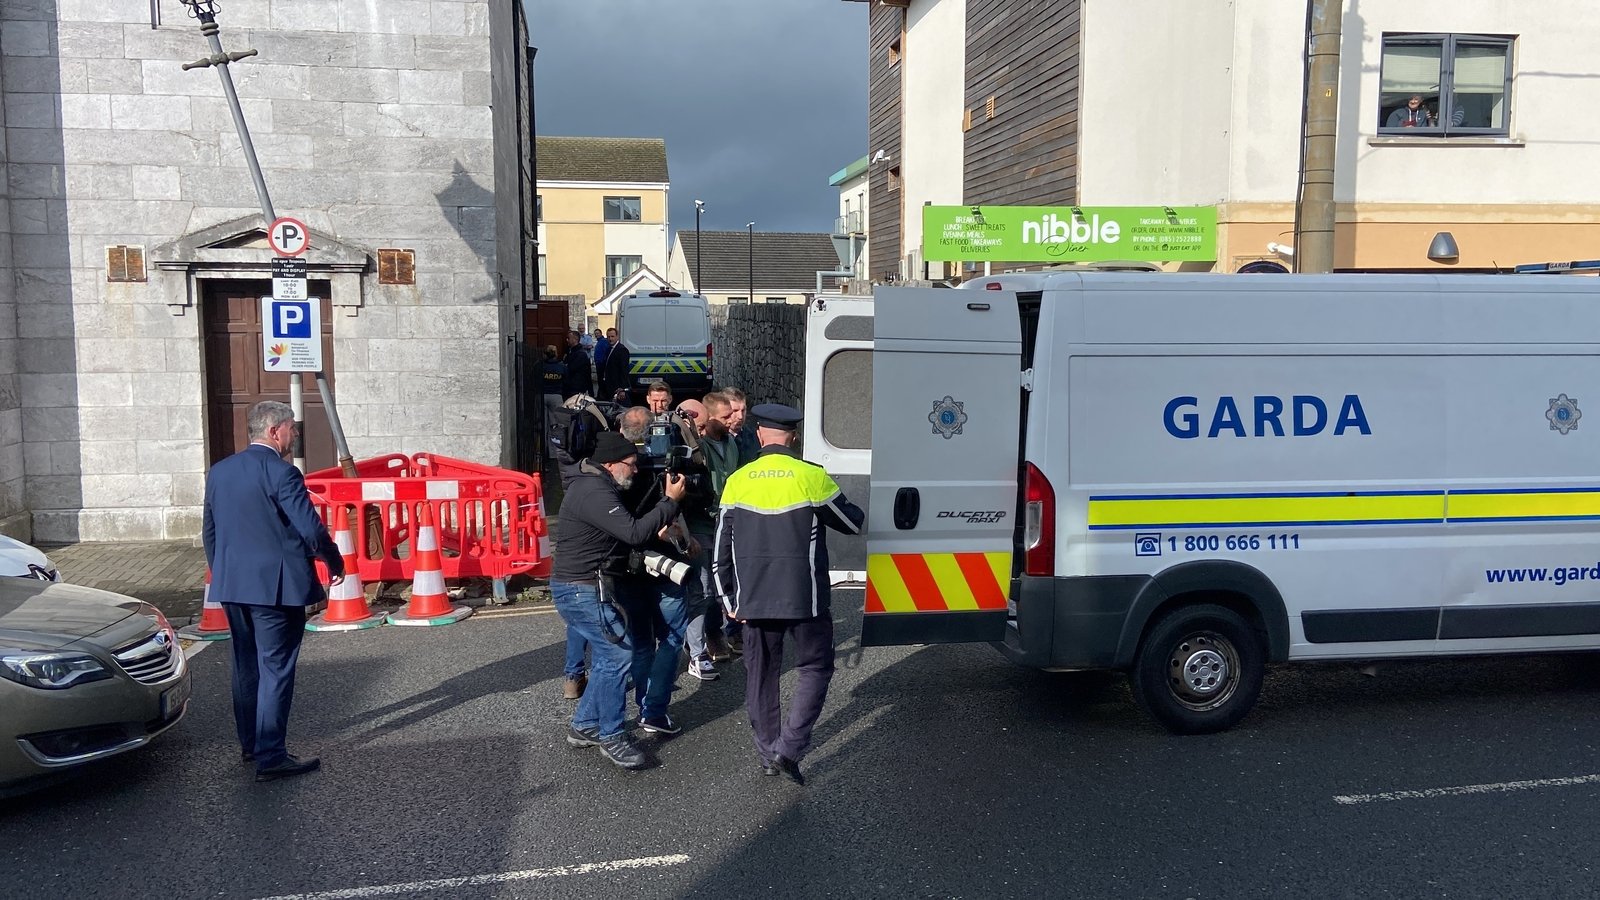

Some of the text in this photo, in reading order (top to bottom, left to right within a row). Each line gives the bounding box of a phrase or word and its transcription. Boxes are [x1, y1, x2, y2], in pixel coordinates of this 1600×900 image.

[282, 225, 298, 248] P
[943, 231, 985, 239] EVENING MEALS
[1022, 213, 1121, 244] nibble
[1040, 235, 1089, 257] Diner
[279, 305, 304, 335] P
[1163, 394, 1371, 439] GARDA
[748, 470, 795, 480] GARDA
[1168, 534, 1299, 551] 1 800 666 111
[1486, 562, 1600, 586] www.gard
